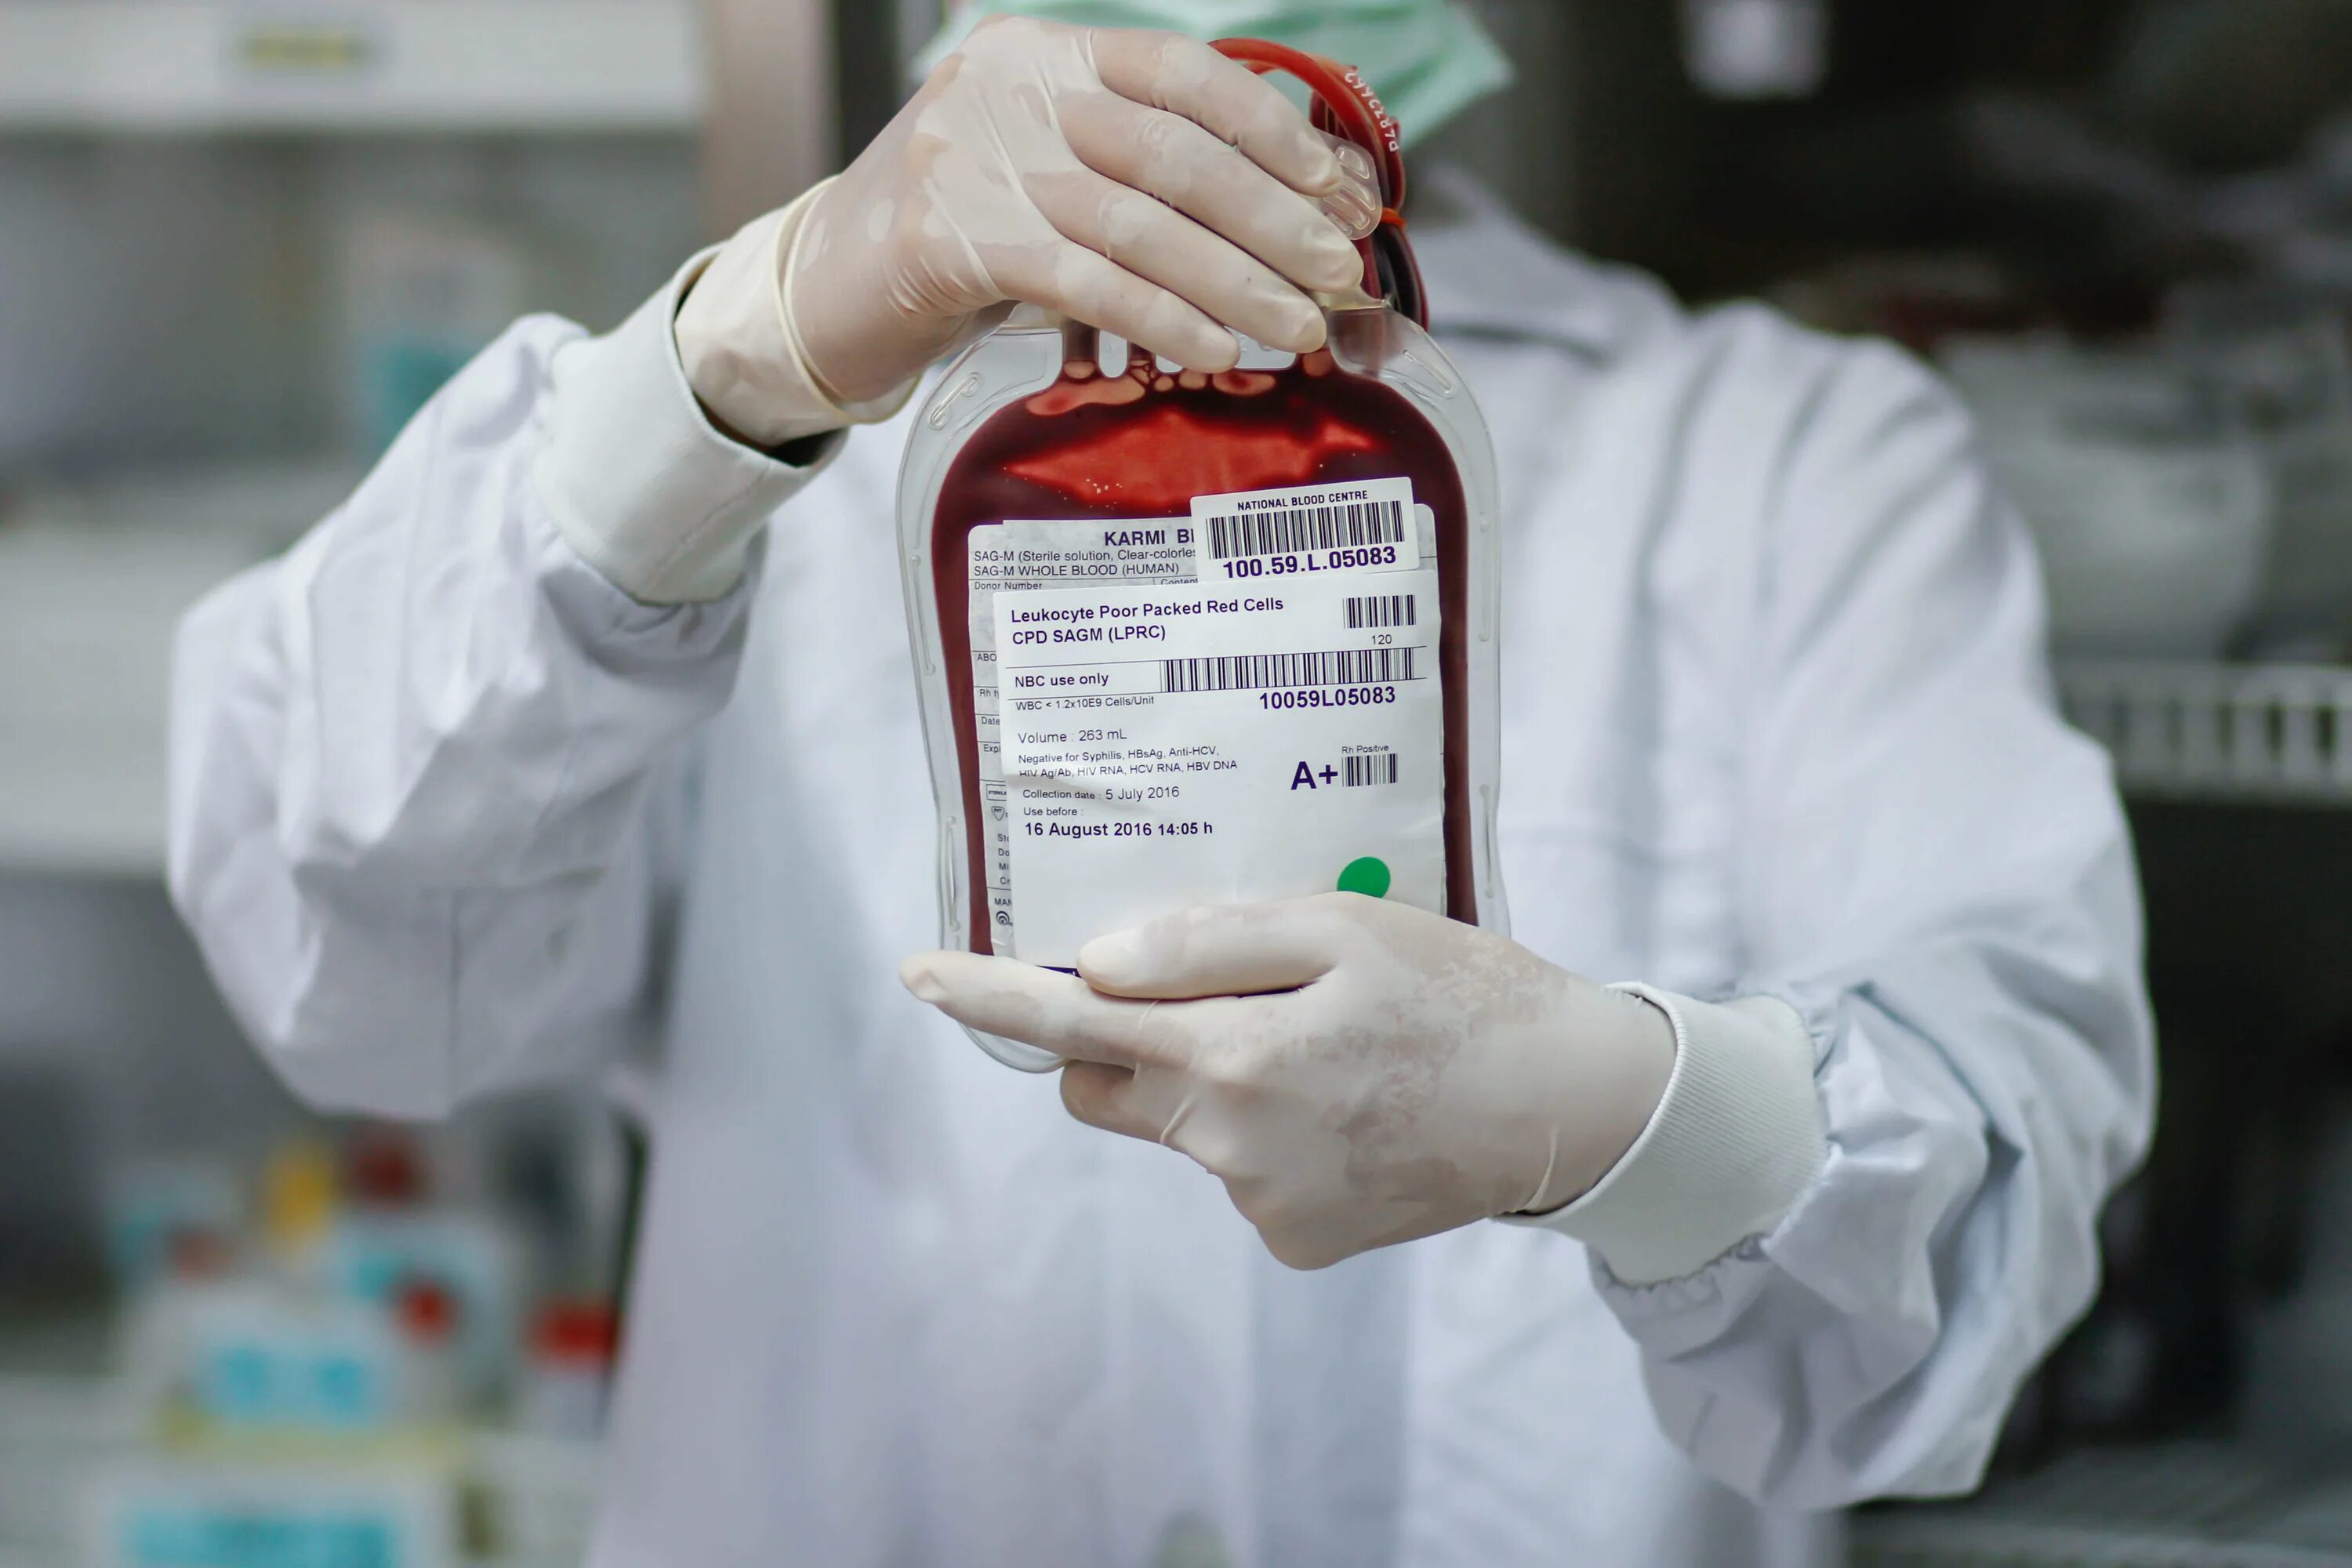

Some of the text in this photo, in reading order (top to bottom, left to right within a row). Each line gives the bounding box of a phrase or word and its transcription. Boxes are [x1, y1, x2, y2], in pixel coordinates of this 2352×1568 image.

[1238, 490, 1367, 510] NATIONAL BLOOD CENTRE
[1104, 530, 1165, 546] KARMI
[974, 550, 1014, 562] SAG-M
[1018, 550, 1060, 563] (Sterile
[1065, 550, 1113, 563] solution,
[1223, 546, 1396, 579] 100.59.L.05083
[974, 563, 1179, 577] SAG-M WHOLE BLOOD (HUMAN)
[1011, 597, 1284, 623] Leukocyte Poor Packed Red Cells
[1012, 625, 1166, 645] CPD SAGM (LPRC)
[1371, 634, 1392, 645] 120
[1015, 673, 1109, 688] NBC use only
[1016, 701, 1043, 710] WBC
[1056, 699, 1102, 710] 1.2x10E9
[1105, 696, 1155, 707] Cells/Unit
[1259, 687, 1396, 710] 10059L05083
[982, 717, 1000, 725] Date
[1018, 731, 1067, 743] Volume
[1079, 729, 1103, 741] 263
[1107, 728, 1127, 740] mL
[1018, 746, 1219, 765] Negative for Syphilis, HBsAg, Anti-HCV,
[1356, 744, 1389, 753] Positive
[1040, 768, 1074, 779] Ag/Ab,
[1077, 767, 1096, 776] HIV
[1099, 765, 1127, 775] RNA,
[1130, 764, 1153, 775] HCV
[1157, 763, 1184, 774] RNA,
[1187, 762, 1210, 771] HBV
[1214, 760, 1238, 770] DNA
[1290, 760, 1338, 790] A+
[1022, 789, 1072, 800] Collection
[1074, 791, 1095, 800] date
[1105, 789, 1113, 800] 5
[1118, 788, 1143, 801] July
[1148, 786, 1180, 799] 2016
[1023, 807, 1044, 816] Use
[1047, 807, 1077, 816] before
[1025, 822, 1213, 838] 16 August 2016 14:05 h
